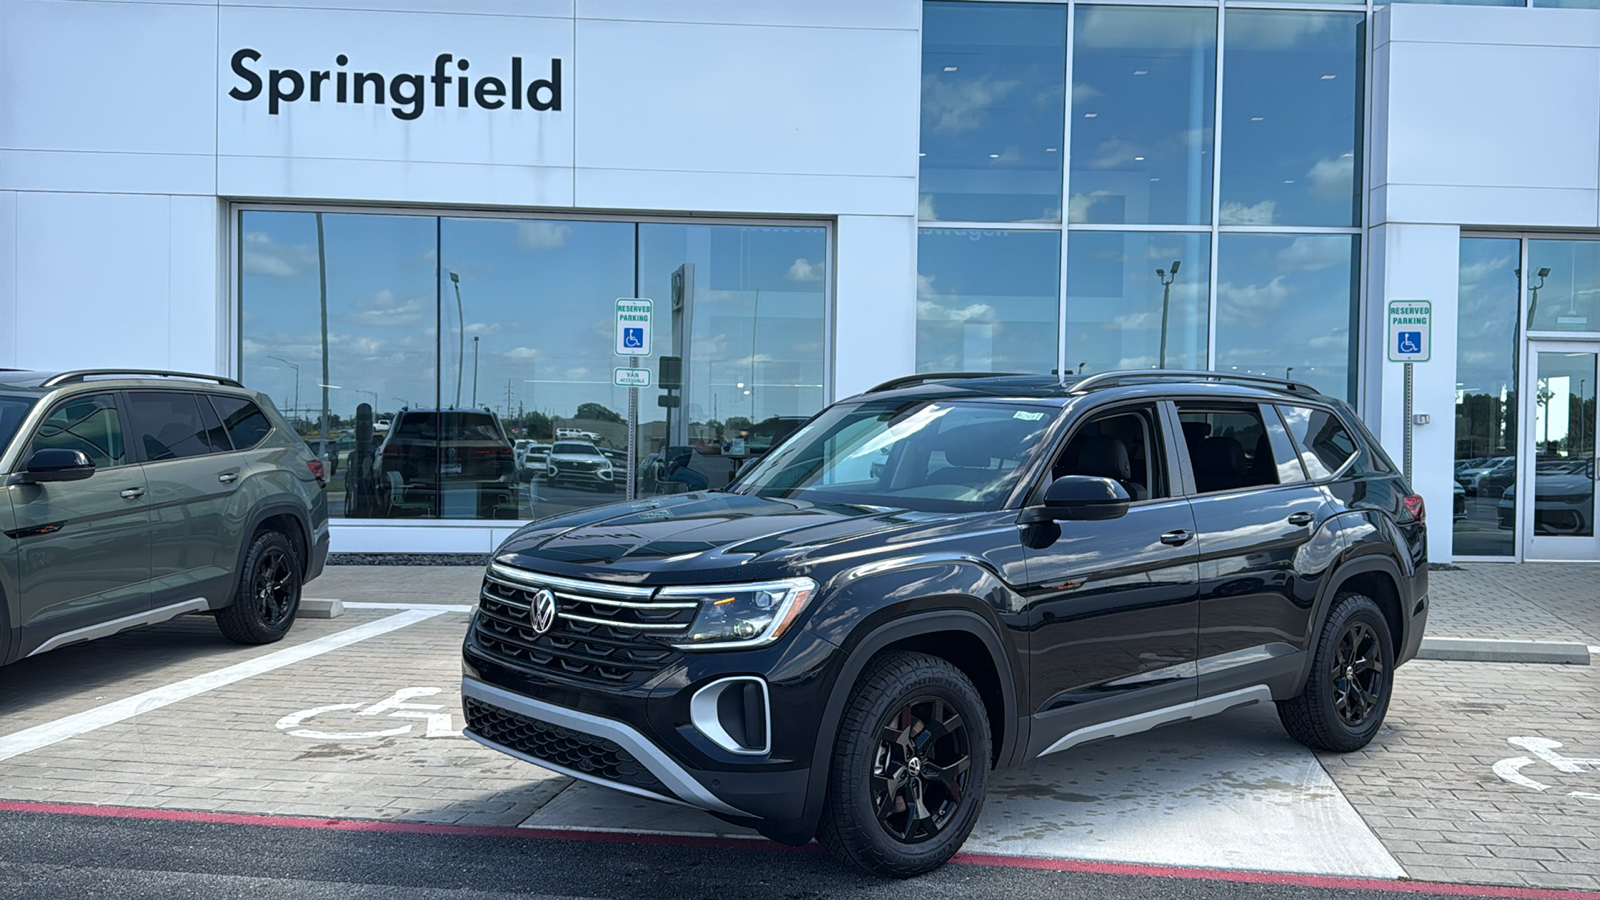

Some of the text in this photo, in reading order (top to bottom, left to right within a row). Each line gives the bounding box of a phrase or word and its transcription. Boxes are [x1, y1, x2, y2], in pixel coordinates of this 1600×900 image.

[228, 48, 562, 121] Springfield
[618, 305, 650, 313] RESERVED
[1391, 307, 1429, 315] RESERVED
[619, 314, 648, 322] PARKING
[1393, 317, 1427, 325] PARKING
[899, 676, 968, 700] CONTINENTAL
